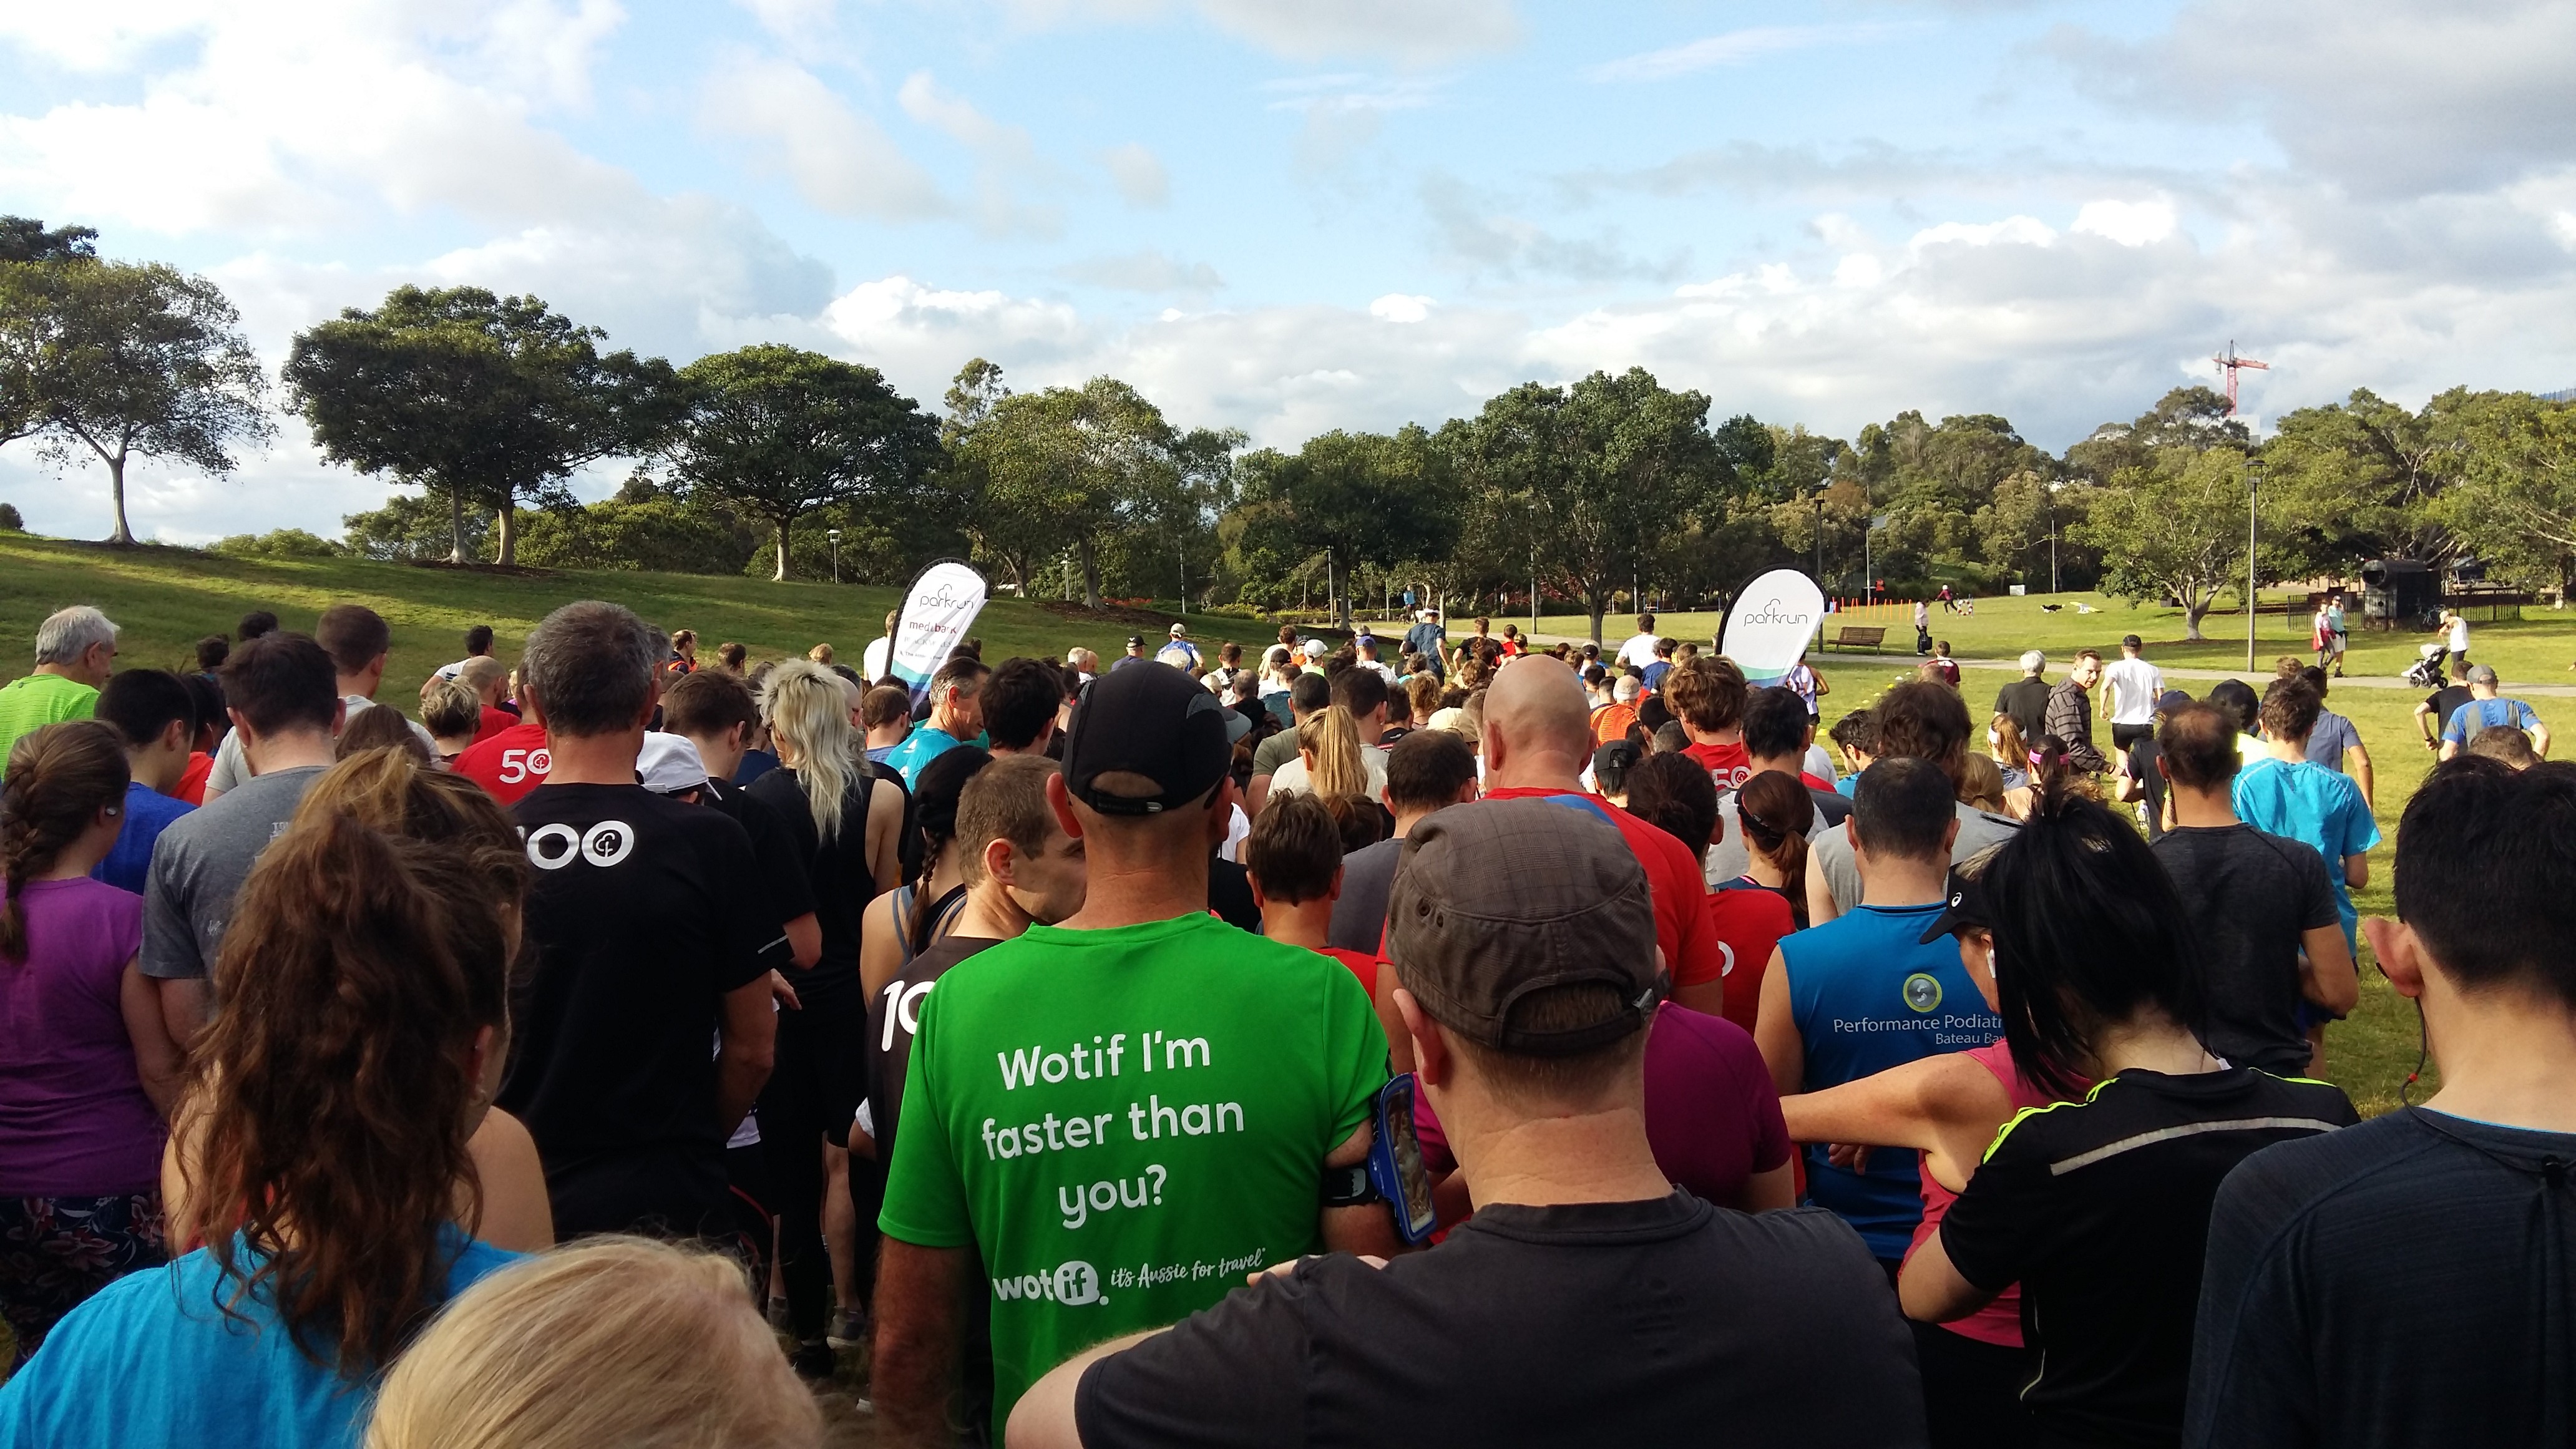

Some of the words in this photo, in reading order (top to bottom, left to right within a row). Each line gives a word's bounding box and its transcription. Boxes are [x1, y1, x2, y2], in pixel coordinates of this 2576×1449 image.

[919, 584, 973, 609] parkrun
[1744, 598, 1808, 627] parkrun
[499, 748, 552, 784] 50
[1712, 766, 1751, 789] 50
[515, 820, 635, 870] 00
[1833, 1017, 1940, 1033] Performance
[1944, 1013, 2003, 1029] Podiatr
[1936, 1033, 1979, 1045] Bateau
[998, 1033, 1126, 1091] Wotif
[1142, 1030, 1211, 1073] I'm
[982, 1112, 1113, 1161] faster
[1128, 1095, 1244, 1141] than
[1058, 1164, 1167, 1229] you?
[1111, 1267, 1136, 1288] it's
[1137, 1262, 1189, 1289] Aussie
[1191, 1260, 1216, 1281] for
